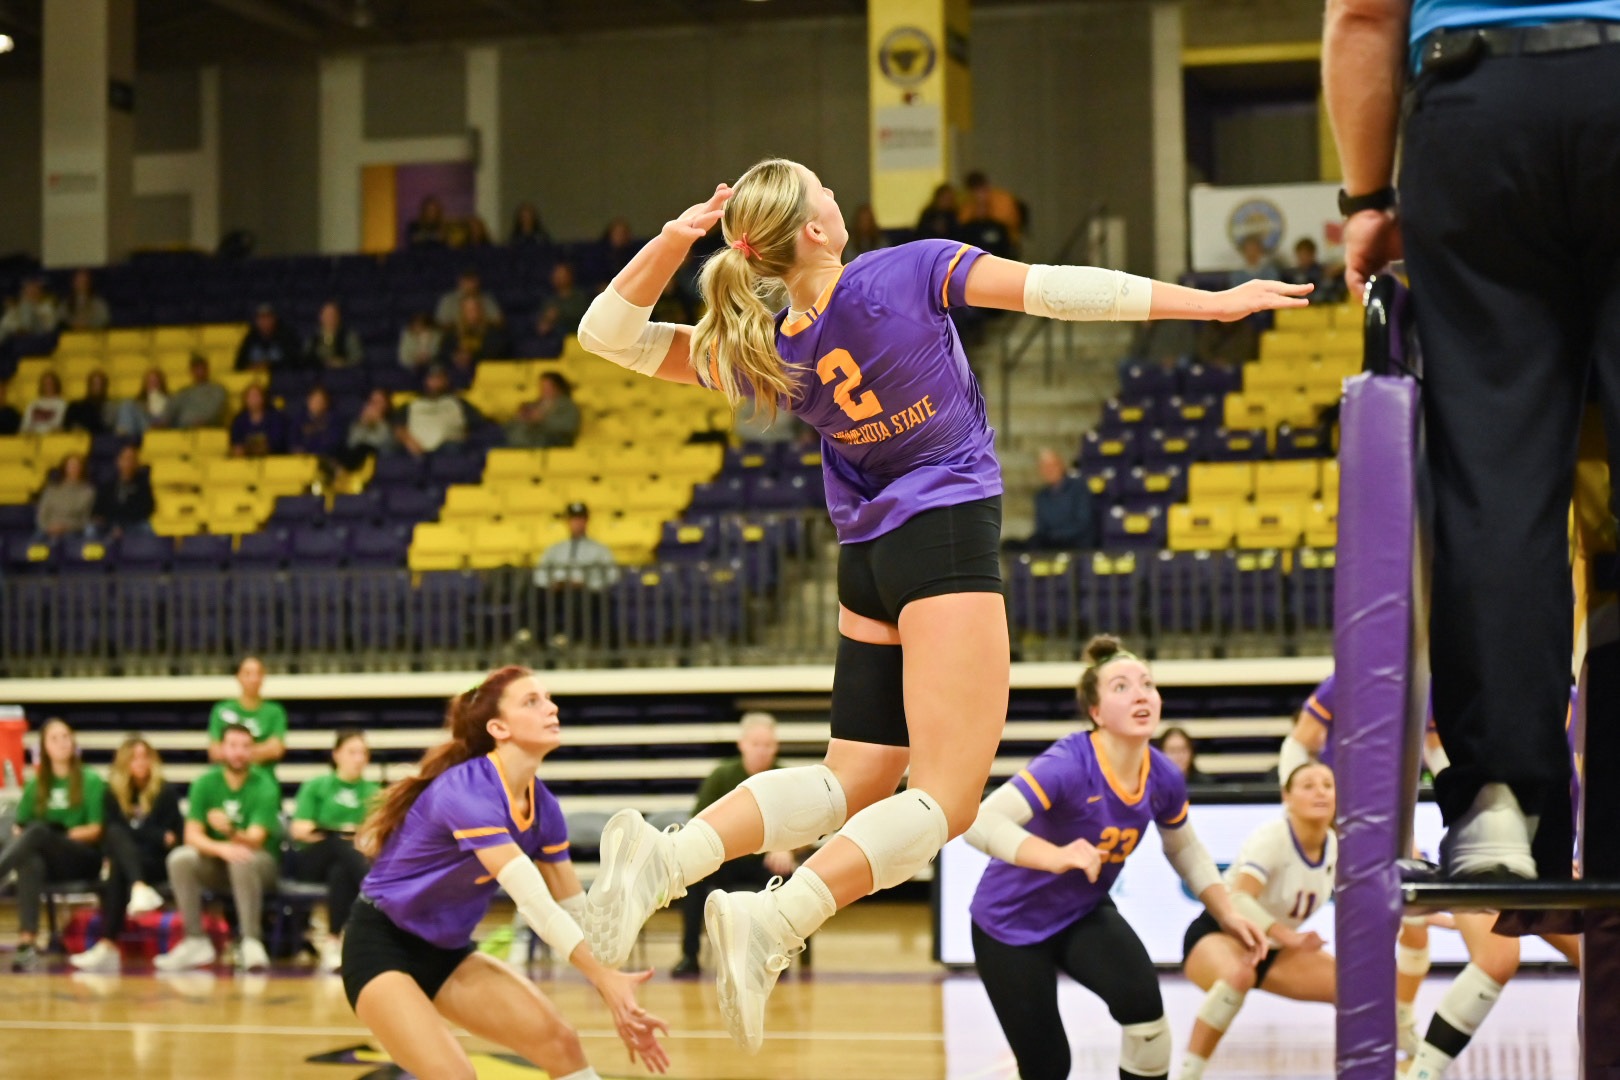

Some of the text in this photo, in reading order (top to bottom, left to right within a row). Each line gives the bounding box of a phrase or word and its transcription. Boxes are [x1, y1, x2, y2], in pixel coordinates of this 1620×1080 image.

[816, 347, 884, 422] 2
[890, 394, 937, 435] STATE
[1096, 826, 1139, 864] 23
[1288, 890, 1316, 919] 11
